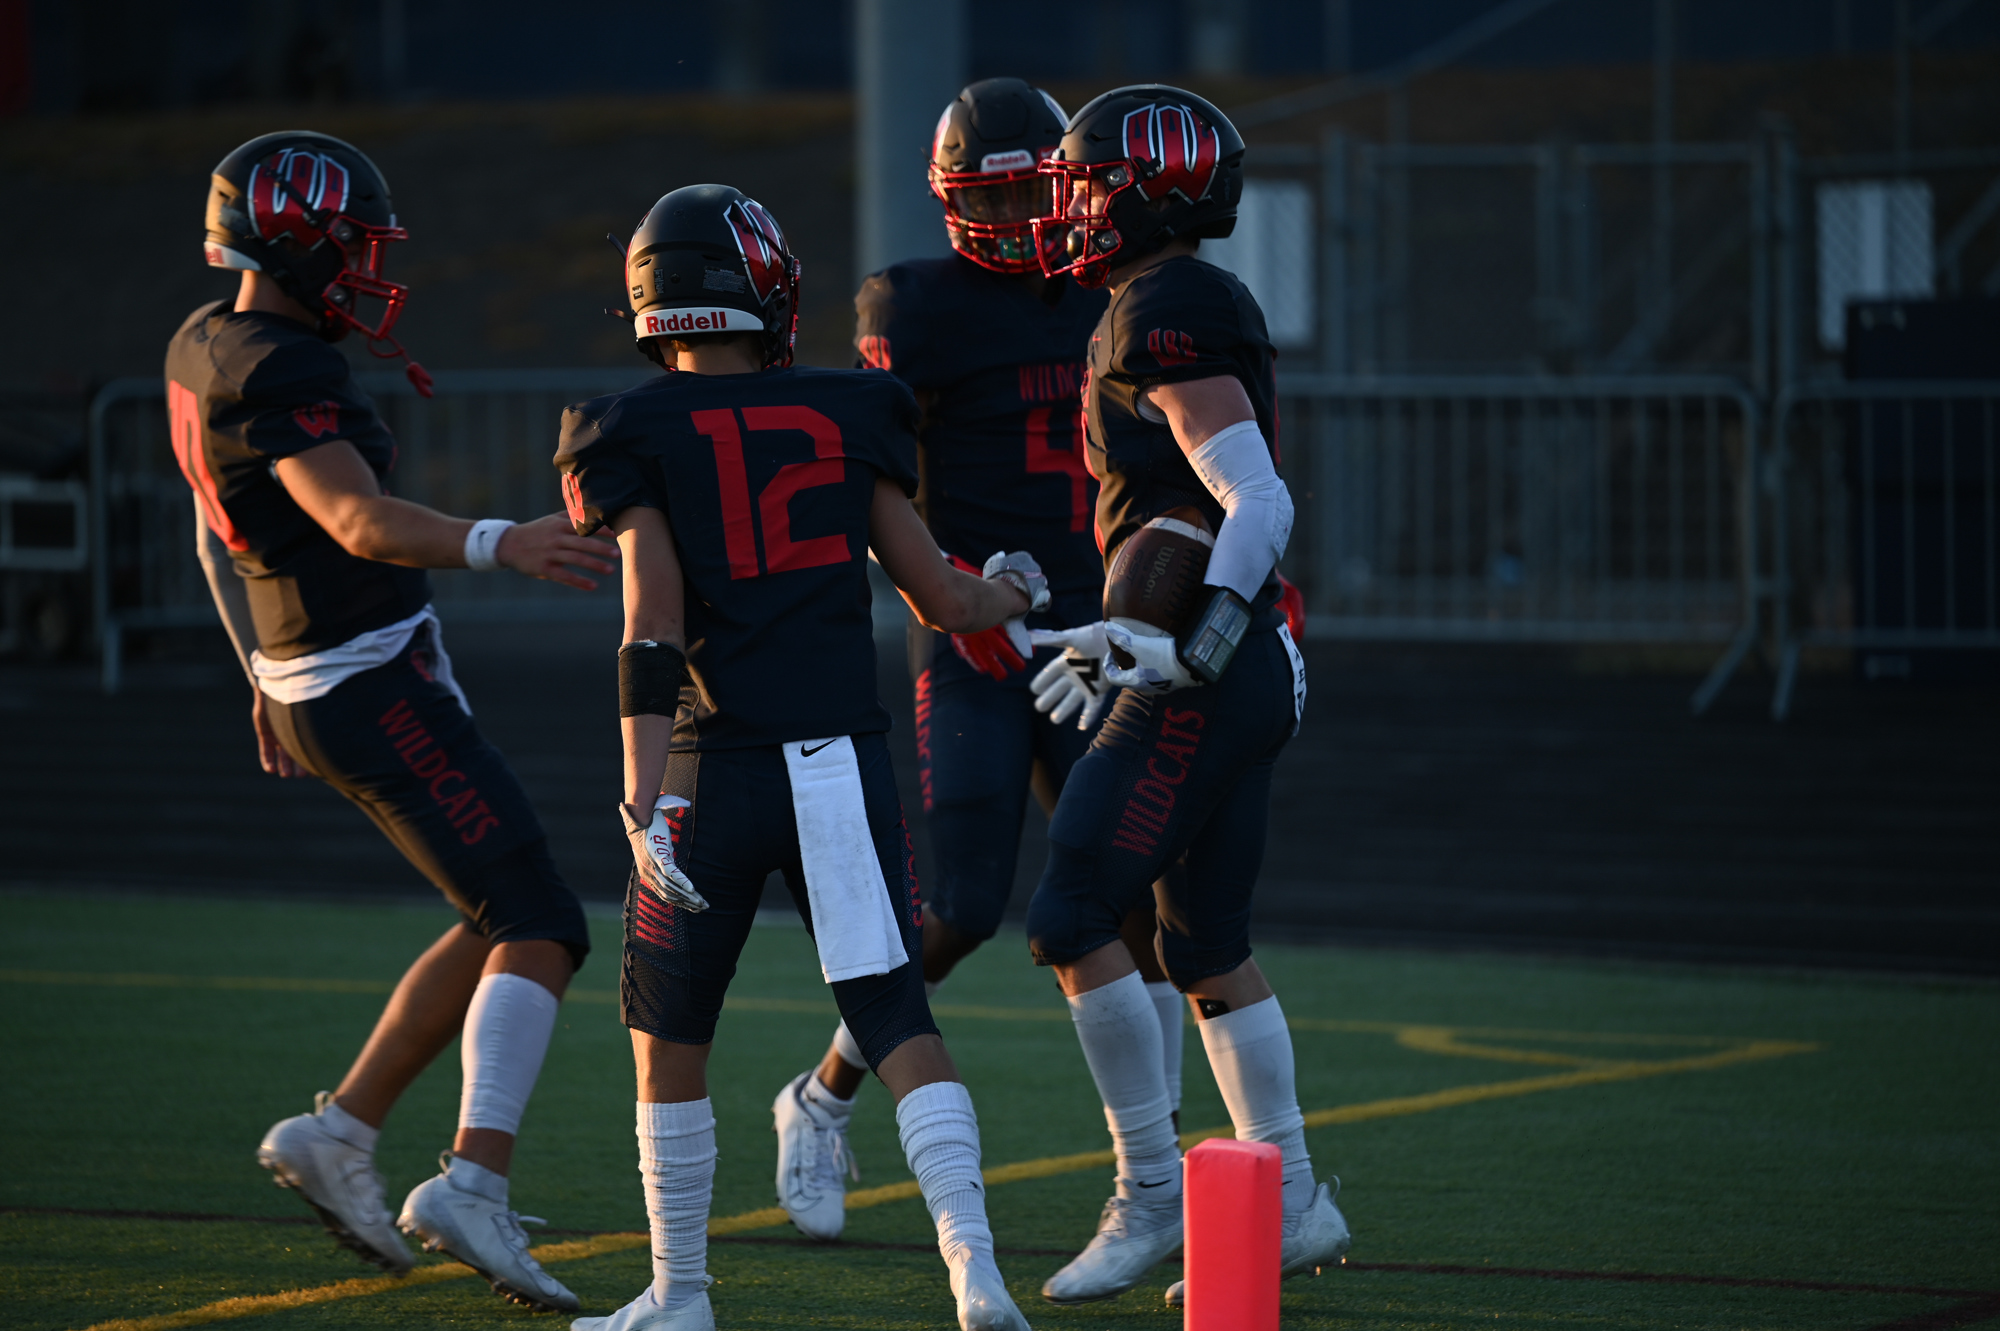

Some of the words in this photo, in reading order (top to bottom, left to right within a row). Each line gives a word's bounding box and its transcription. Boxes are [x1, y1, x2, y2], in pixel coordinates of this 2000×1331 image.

[987, 153, 1027, 167] Riddell
[646, 312, 727, 334] Riddell
[690, 404, 852, 580] 12
[1024, 405, 1090, 533] 4
[1143, 546, 1176, 600] Wilson
[378, 698, 500, 846] WILDCATS
[1112, 706, 1206, 856] WILDCATS
